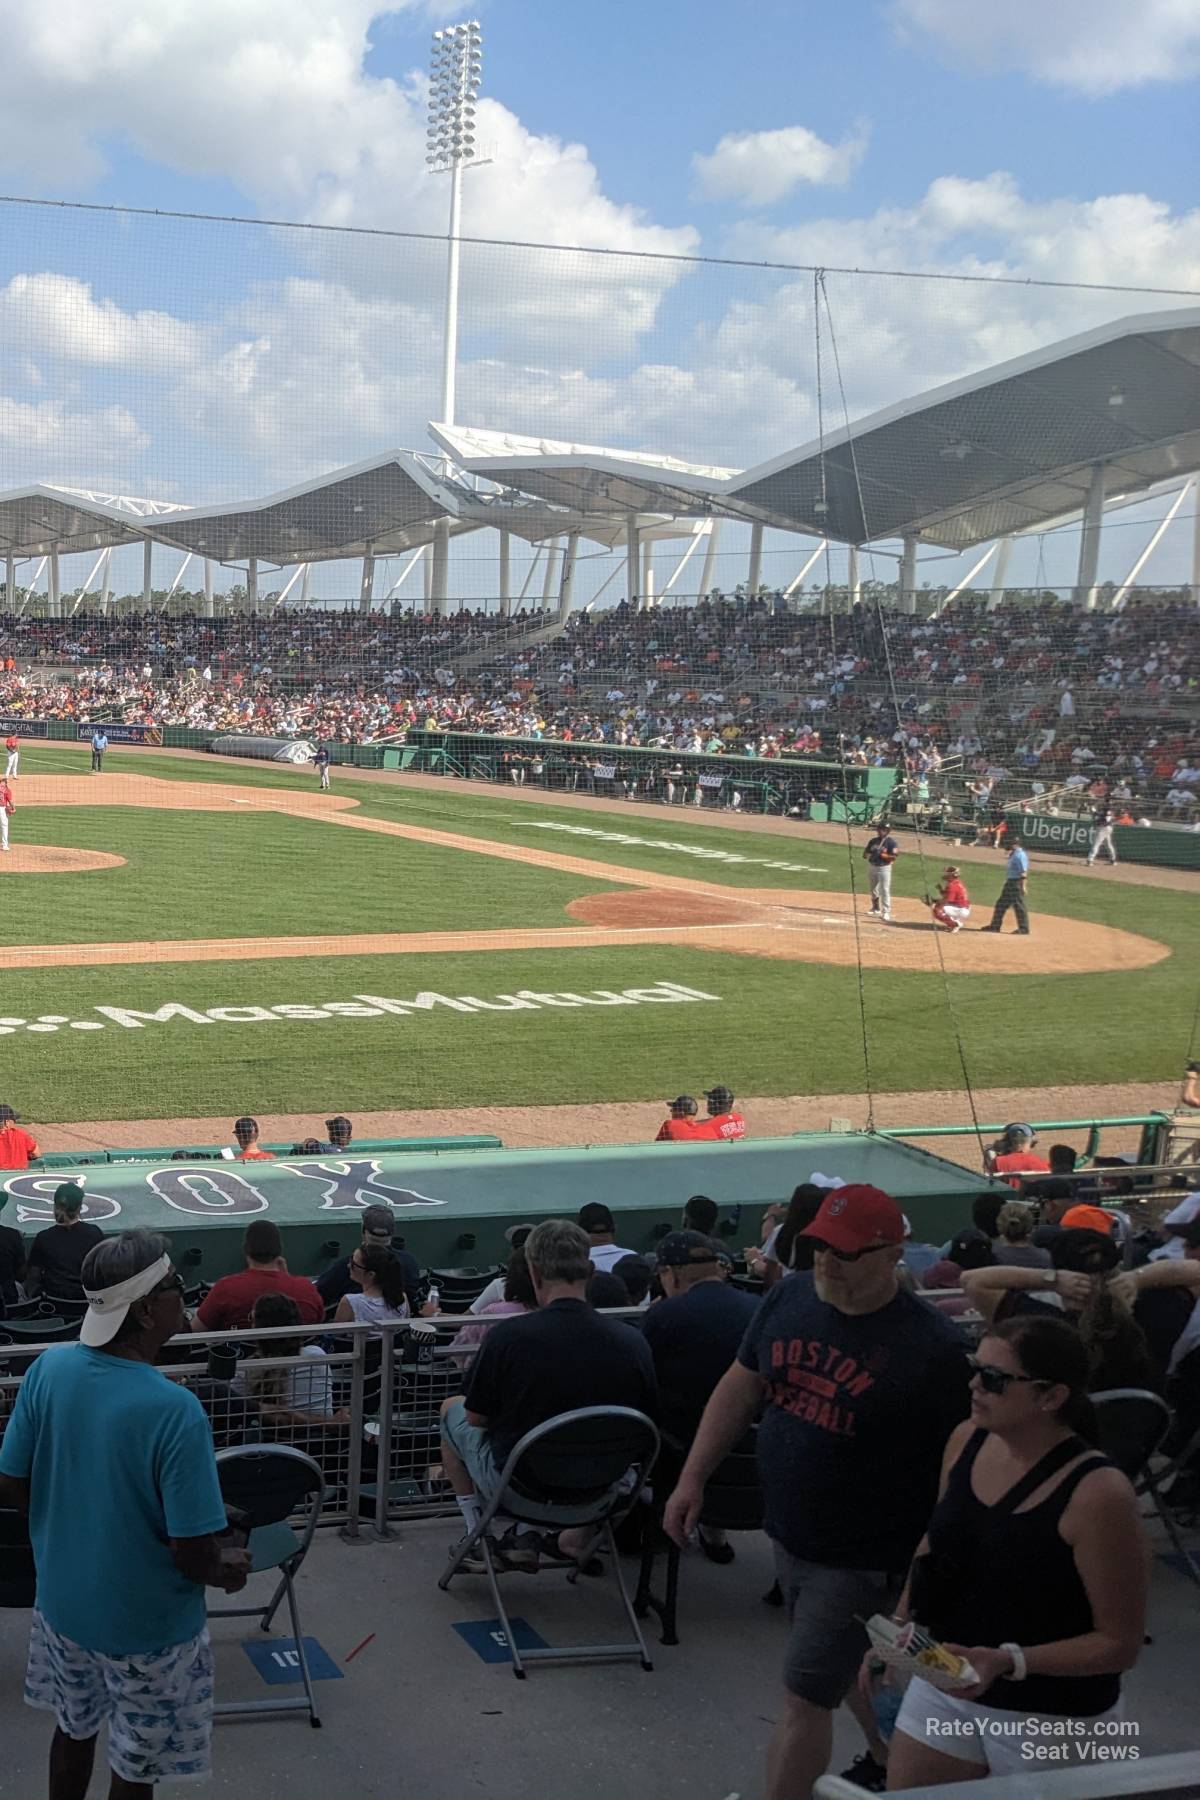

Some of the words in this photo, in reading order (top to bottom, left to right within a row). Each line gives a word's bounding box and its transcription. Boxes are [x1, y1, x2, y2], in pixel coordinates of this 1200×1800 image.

[1022, 817, 1096, 845] UberJet
[93, 981, 723, 1028] MassMutual
[3, 1158, 450, 1224] SOX
[771, 1338, 875, 1398] BOSTON
